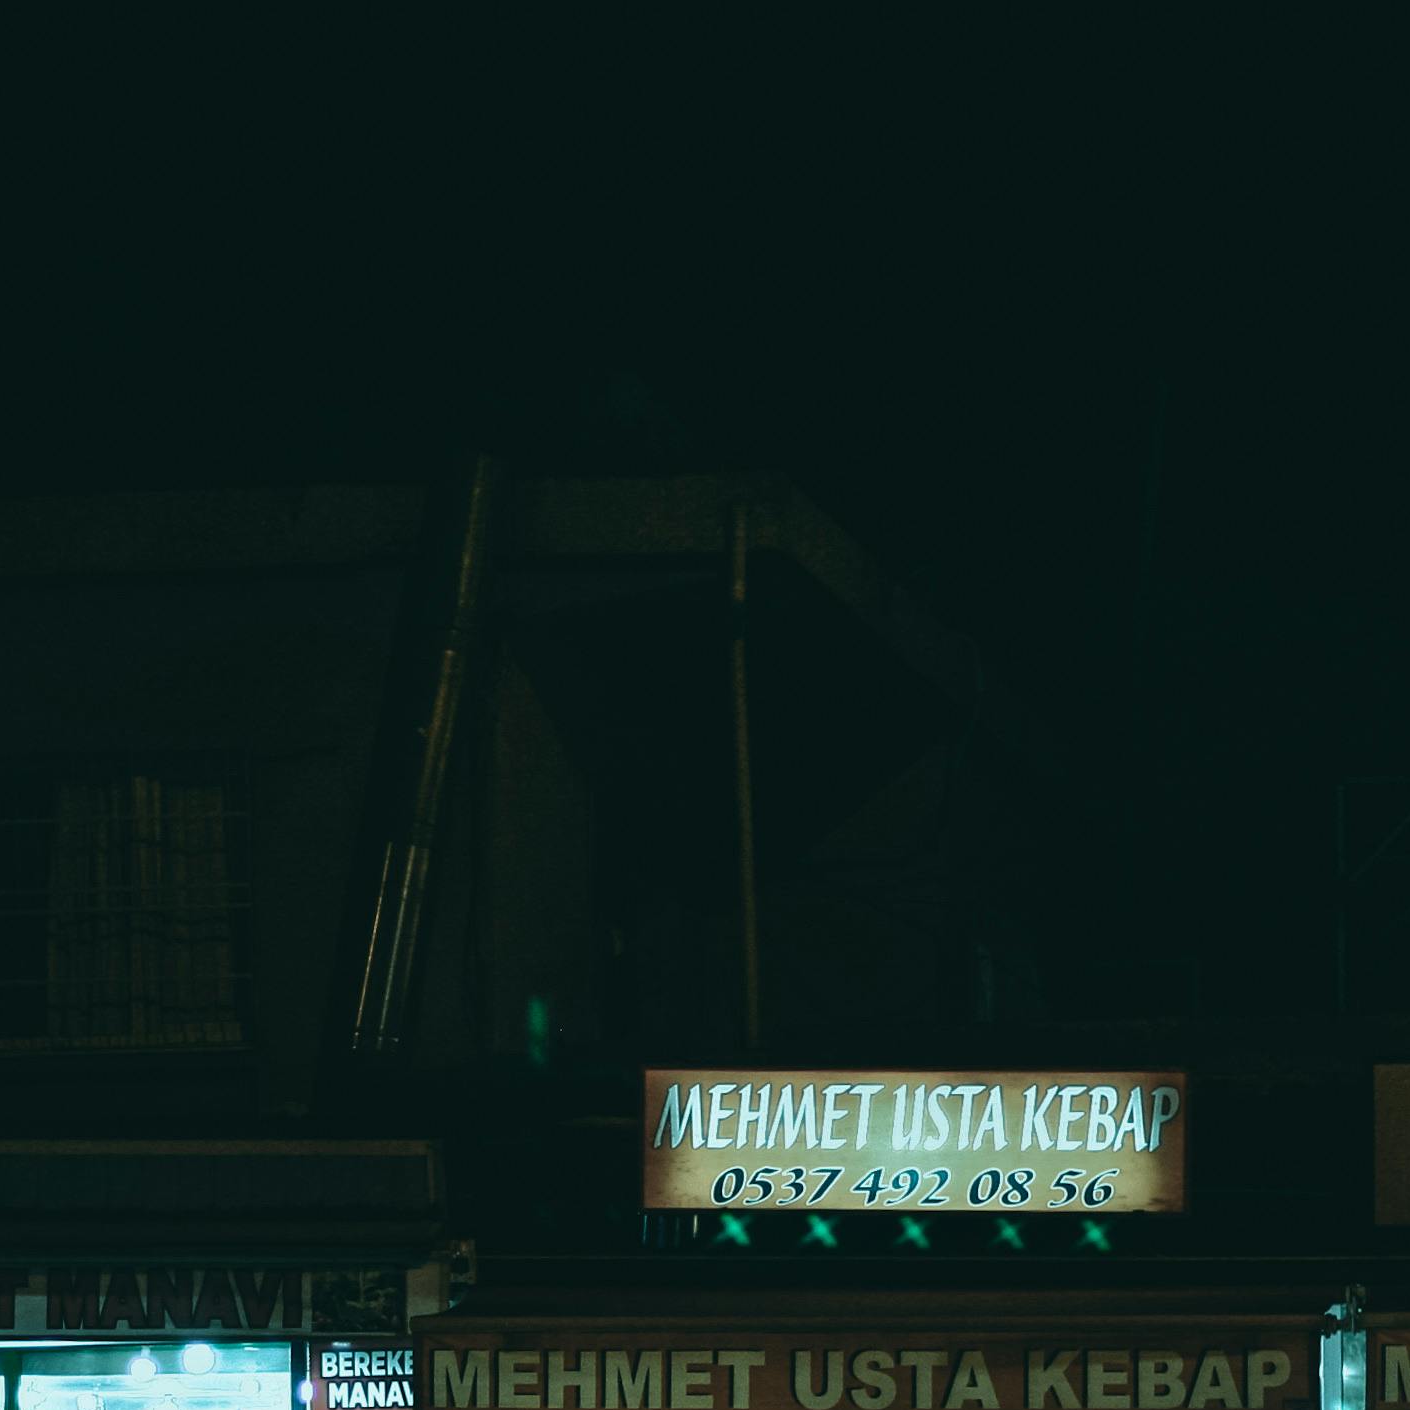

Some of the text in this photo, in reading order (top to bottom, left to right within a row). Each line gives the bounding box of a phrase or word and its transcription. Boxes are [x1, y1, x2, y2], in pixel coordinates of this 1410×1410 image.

[652, 1082, 1181, 1153] MEHMET USTA KEBAP
[710, 1166, 1120, 1207] 0537 492 08 56
[47, 1272, 304, 1329] MANAVI
[432, 1349, 1292, 1410] MEHMET USTA KEBAP
